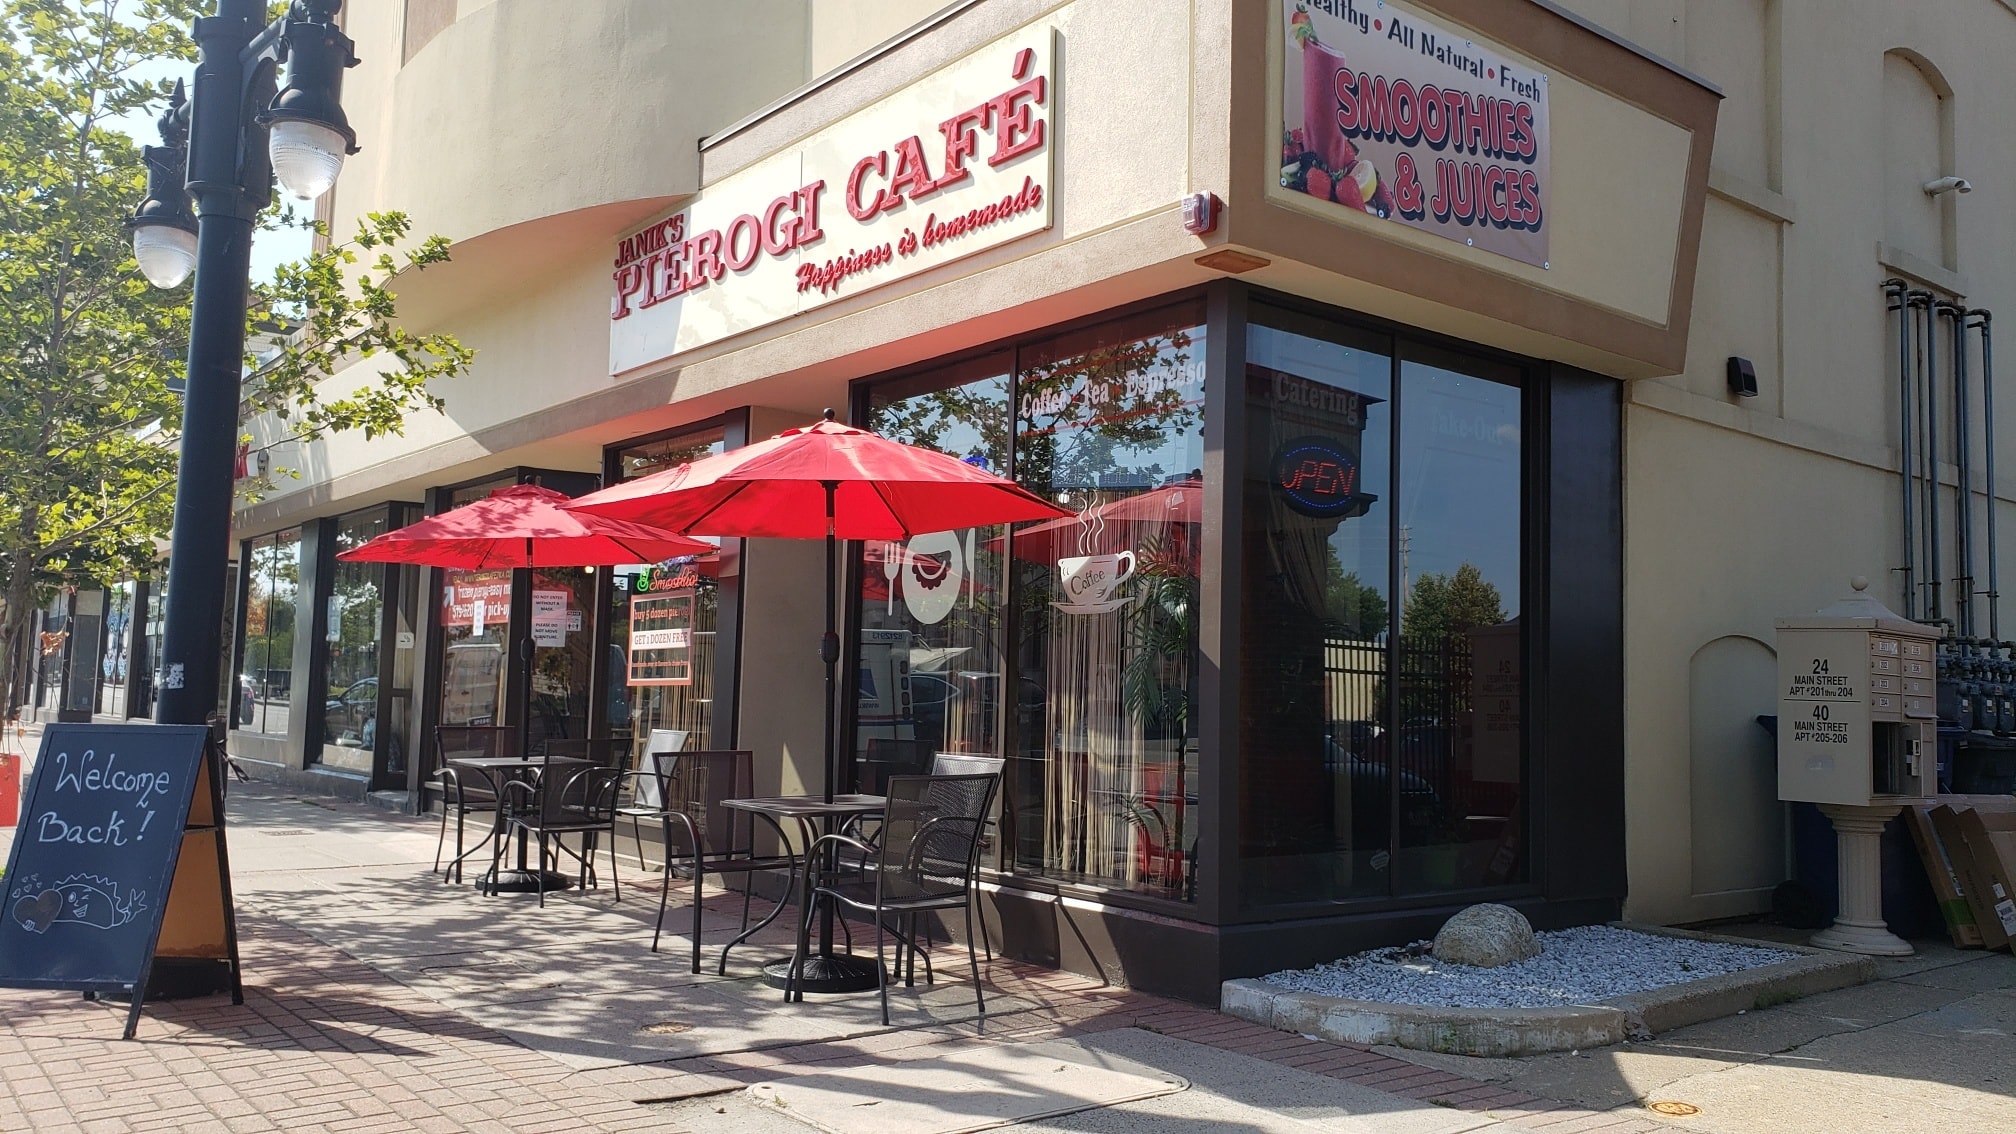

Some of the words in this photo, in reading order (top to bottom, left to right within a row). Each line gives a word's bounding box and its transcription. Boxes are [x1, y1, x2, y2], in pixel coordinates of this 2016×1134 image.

[1303, 0, 1369, 34] ealthy
[1388, 17, 1414, 49] All
[1421, 32, 1484, 79] Natural
[1500, 65, 1540, 103] Fresh
[1334, 67, 1537, 164] SMOOTHIES
[612, 179, 825, 320] PIEROGI
[846, 47, 1045, 221] CAFÉ
[1394, 152, 1425, 221] &
[1431, 158, 1542, 232] JUICES
[614, 213, 684, 268] JANIK'S
[795, 242, 892, 295] Happiness
[898, 228, 917, 256] is
[922, 175, 1042, 248] homemade
[1022, 388, 1067, 418] Coffee
[1082, 379, 1109, 406] Tea
[1126, 361, 1206, 402] Espresso
[1275, 373, 1359, 426] Catering
[1071, 570, 1105, 595] Coffee
[634, 608, 645, 622] buy
[650, 607, 668, 619] dozen
[634, 634, 647, 645] GET
[650, 632, 672, 645] DOZEN
[672, 631, 688, 643] FREE
[1794, 675, 1815, 685] MAIN
[1816, 675, 1848, 686] STREET
[1812, 658, 1829, 675] 24
[1789, 686, 1805, 696] APT
[1825, 689, 1837, 697] thru
[1837, 687, 1853, 697] 204
[1794, 721, 1815, 731] MAIN
[1816, 722, 1848, 732] STREET
[1812, 704, 1829, 721] 40
[1794, 732, 1810, 742] APT
[54, 749, 170, 808] Welcome
